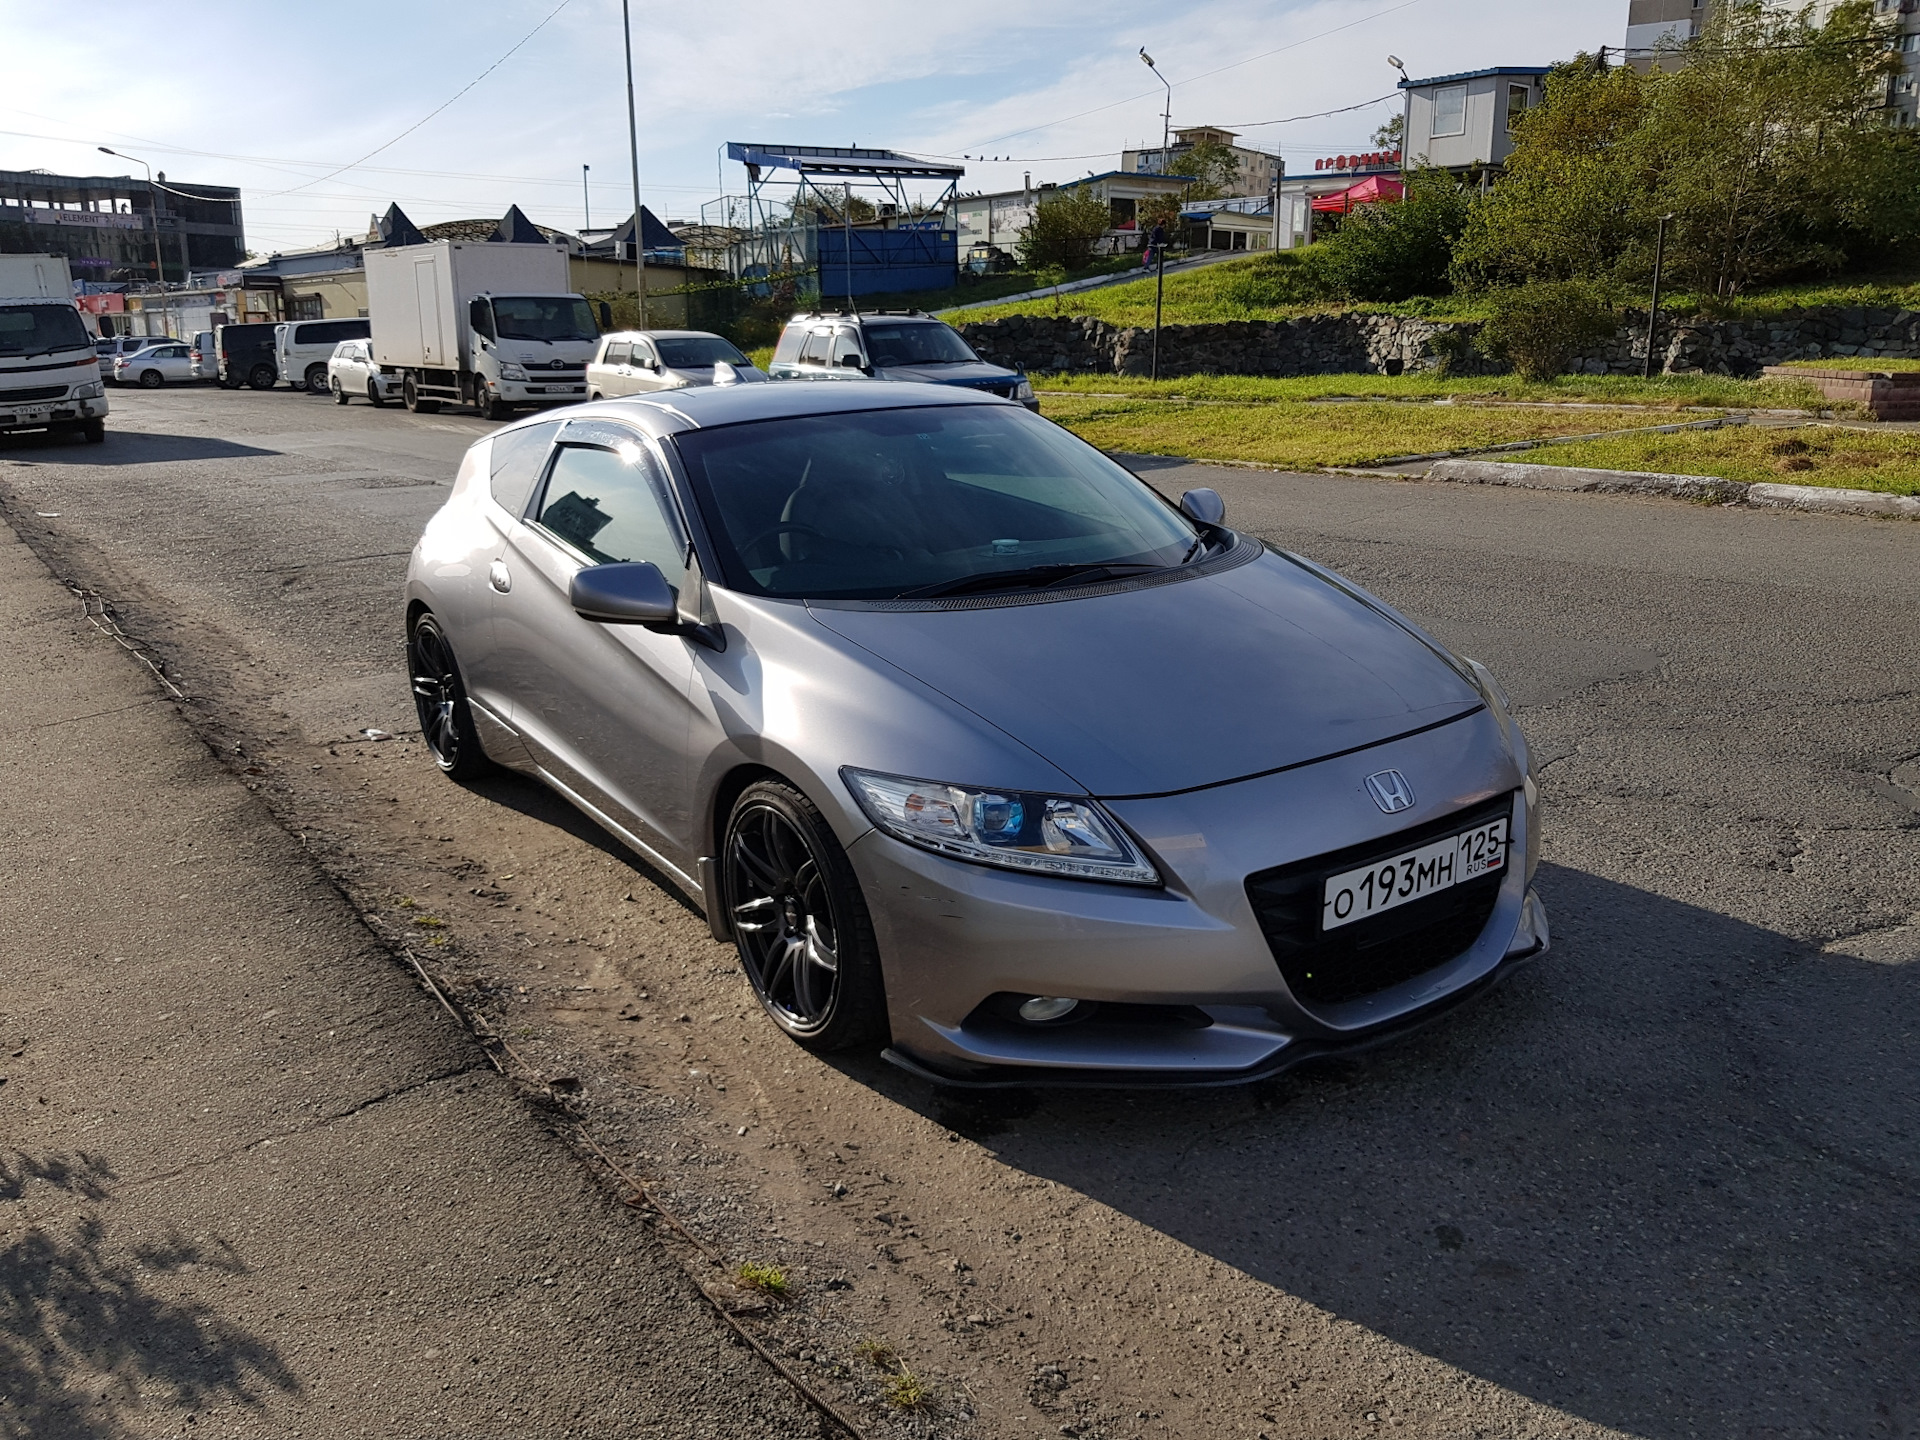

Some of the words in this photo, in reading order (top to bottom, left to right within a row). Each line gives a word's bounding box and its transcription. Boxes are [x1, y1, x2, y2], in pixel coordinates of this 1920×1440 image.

[63, 213, 99, 223] ELEMENT
[1460, 824, 1501, 864] 125
[1466, 858, 1487, 876] RUS
